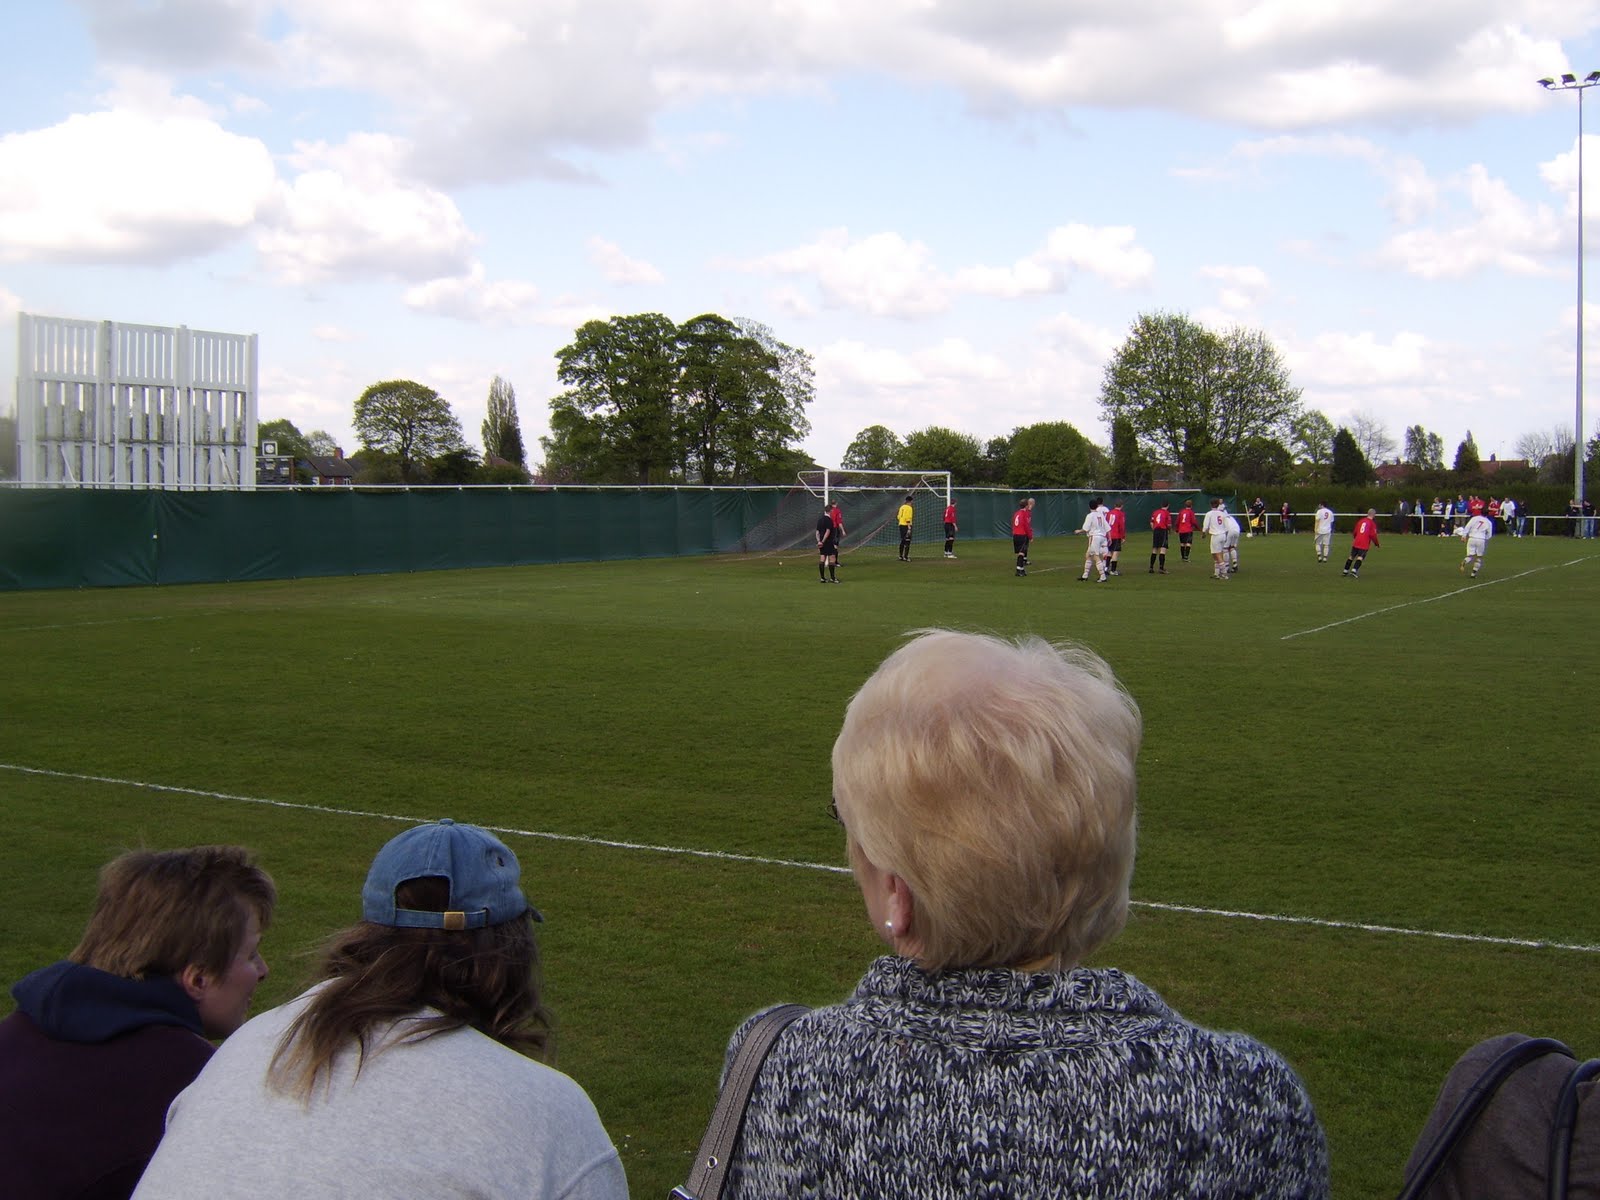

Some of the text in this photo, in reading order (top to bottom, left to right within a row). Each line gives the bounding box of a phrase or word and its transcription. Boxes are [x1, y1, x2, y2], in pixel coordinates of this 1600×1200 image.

[1014, 514, 1020, 526] 6
[1216, 515, 1223, 526] 6
[1323, 512, 1329, 521] 9
[1359, 521, 1366, 534] 8
[1476, 520, 1485, 531] 7
